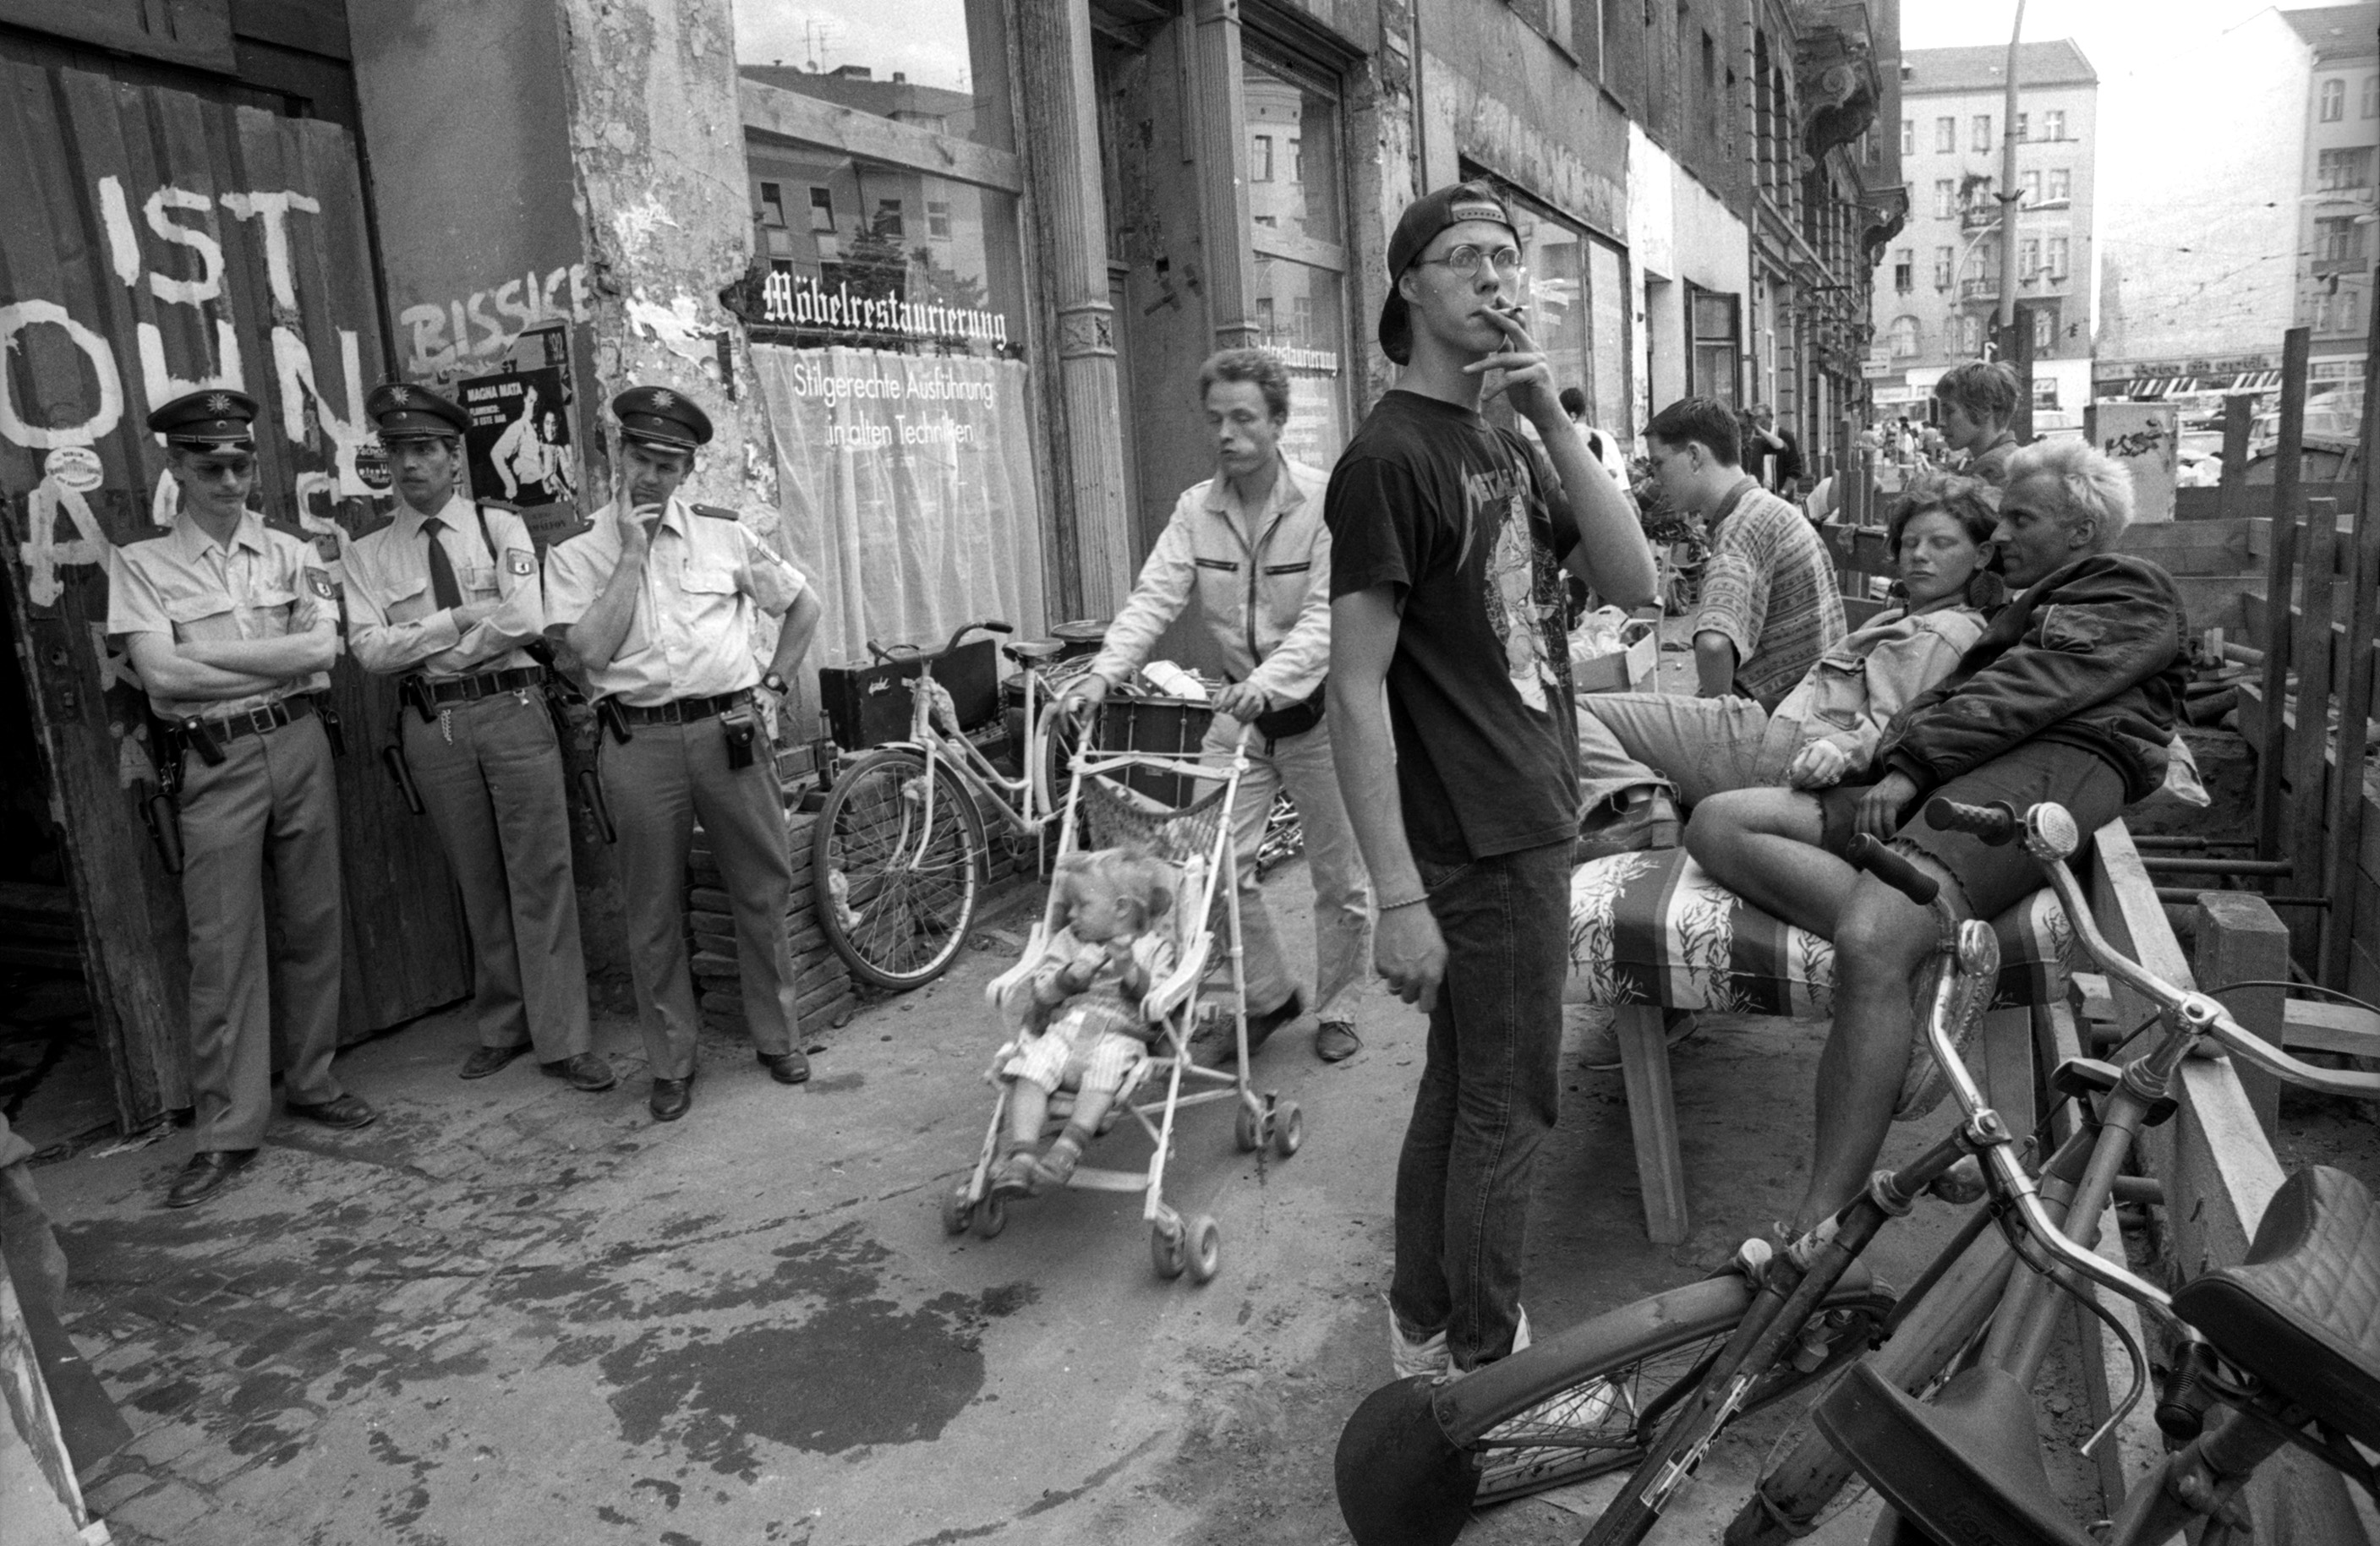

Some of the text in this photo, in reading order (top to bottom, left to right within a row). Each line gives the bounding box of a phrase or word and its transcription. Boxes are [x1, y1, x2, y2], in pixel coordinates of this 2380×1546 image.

[99, 174, 320, 309] IST
[762, 270, 1008, 351] Möbelrestaurierung
[467, 381, 523, 402] MAGNA MATA
[793, 359, 993, 409] Stilgerechte Ausführung
[827, 410, 974, 445] in alten Techniken
